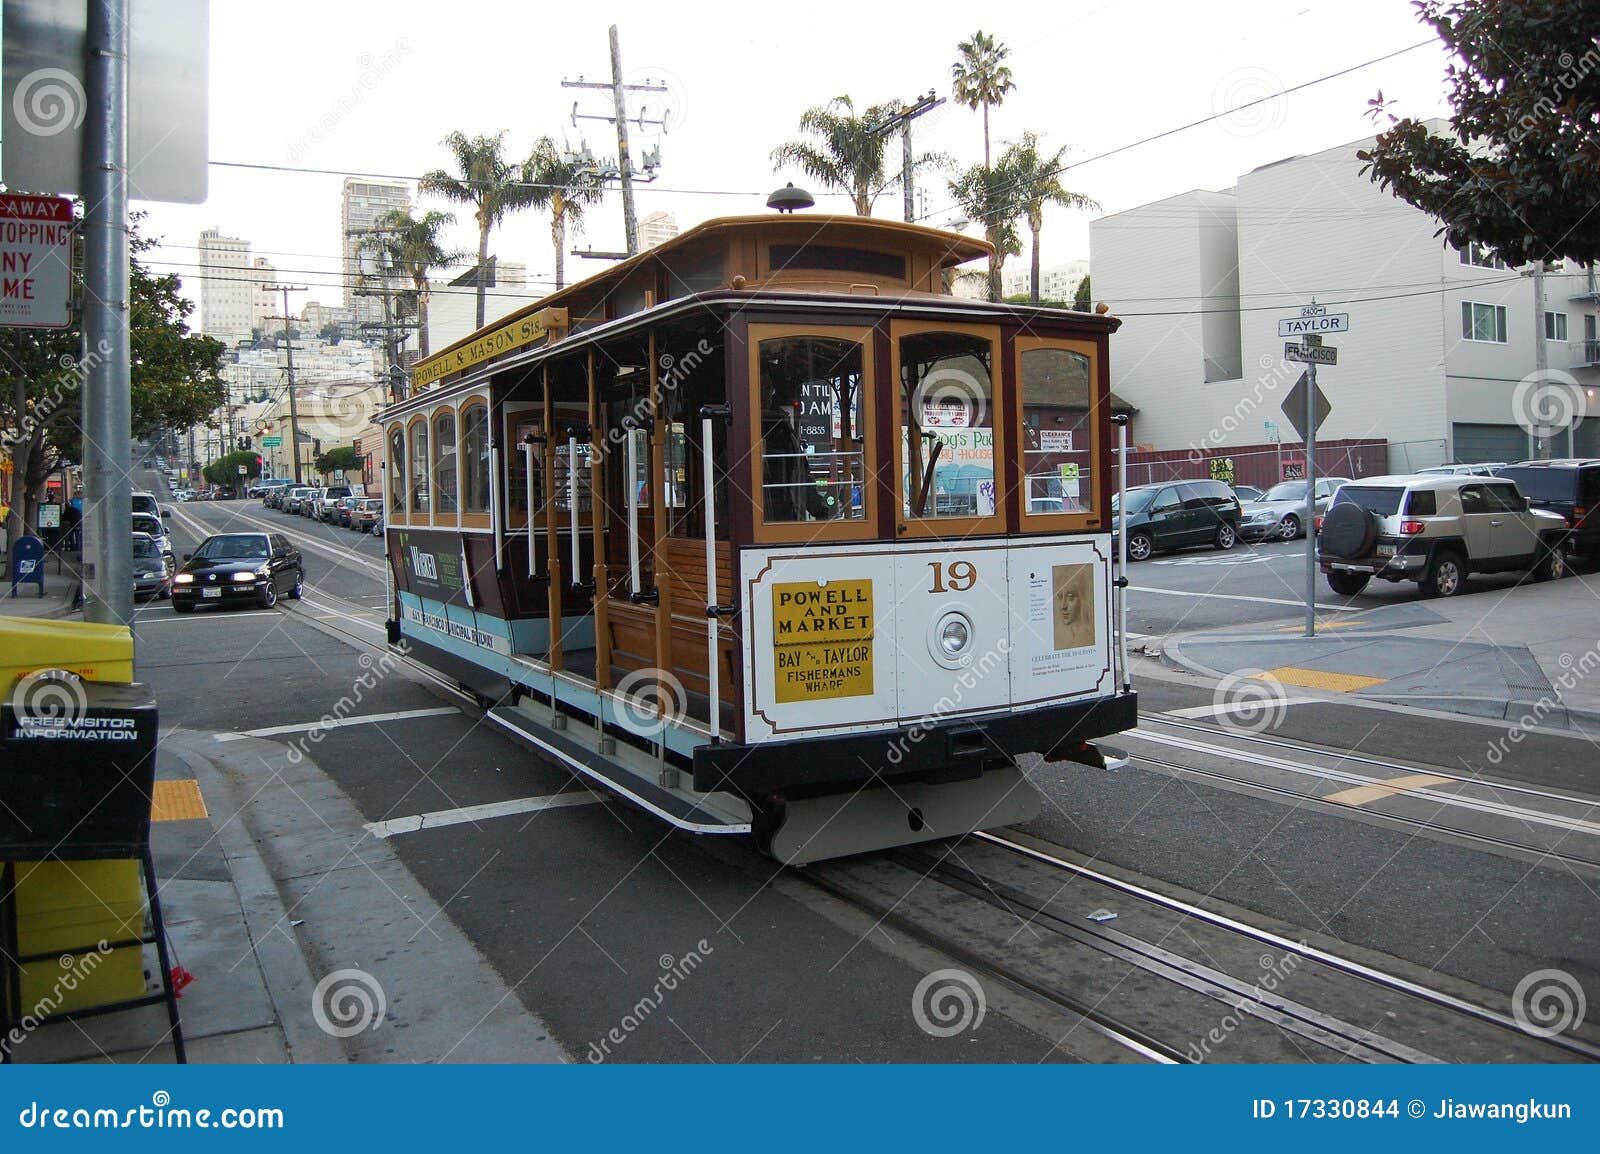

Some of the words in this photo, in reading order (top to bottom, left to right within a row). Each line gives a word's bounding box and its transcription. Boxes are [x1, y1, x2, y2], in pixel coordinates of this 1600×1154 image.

[1286, 318, 1340, 332] TAYLOR
[416, 358, 452, 385] POWELL
[456, 351, 465, 366] &
[470, 328, 515, 362] MASON
[1287, 346, 1337, 361] FRANCISCO
[928, 561, 977, 594] 19
[780, 589, 868, 606] POWELL
[804, 605, 847, 617] AND
[779, 616, 870, 633] MARKET
[779, 652, 801, 668] BAY
[824, 646, 869, 664] TAYLOR
[787, 666, 861, 682] FISHERMANS
[805, 680, 844, 692] WHARF
[20, 717, 65, 728] FREE
[67, 717, 135, 728] VISITOR
[15, 729, 138, 740] INFORMATION
